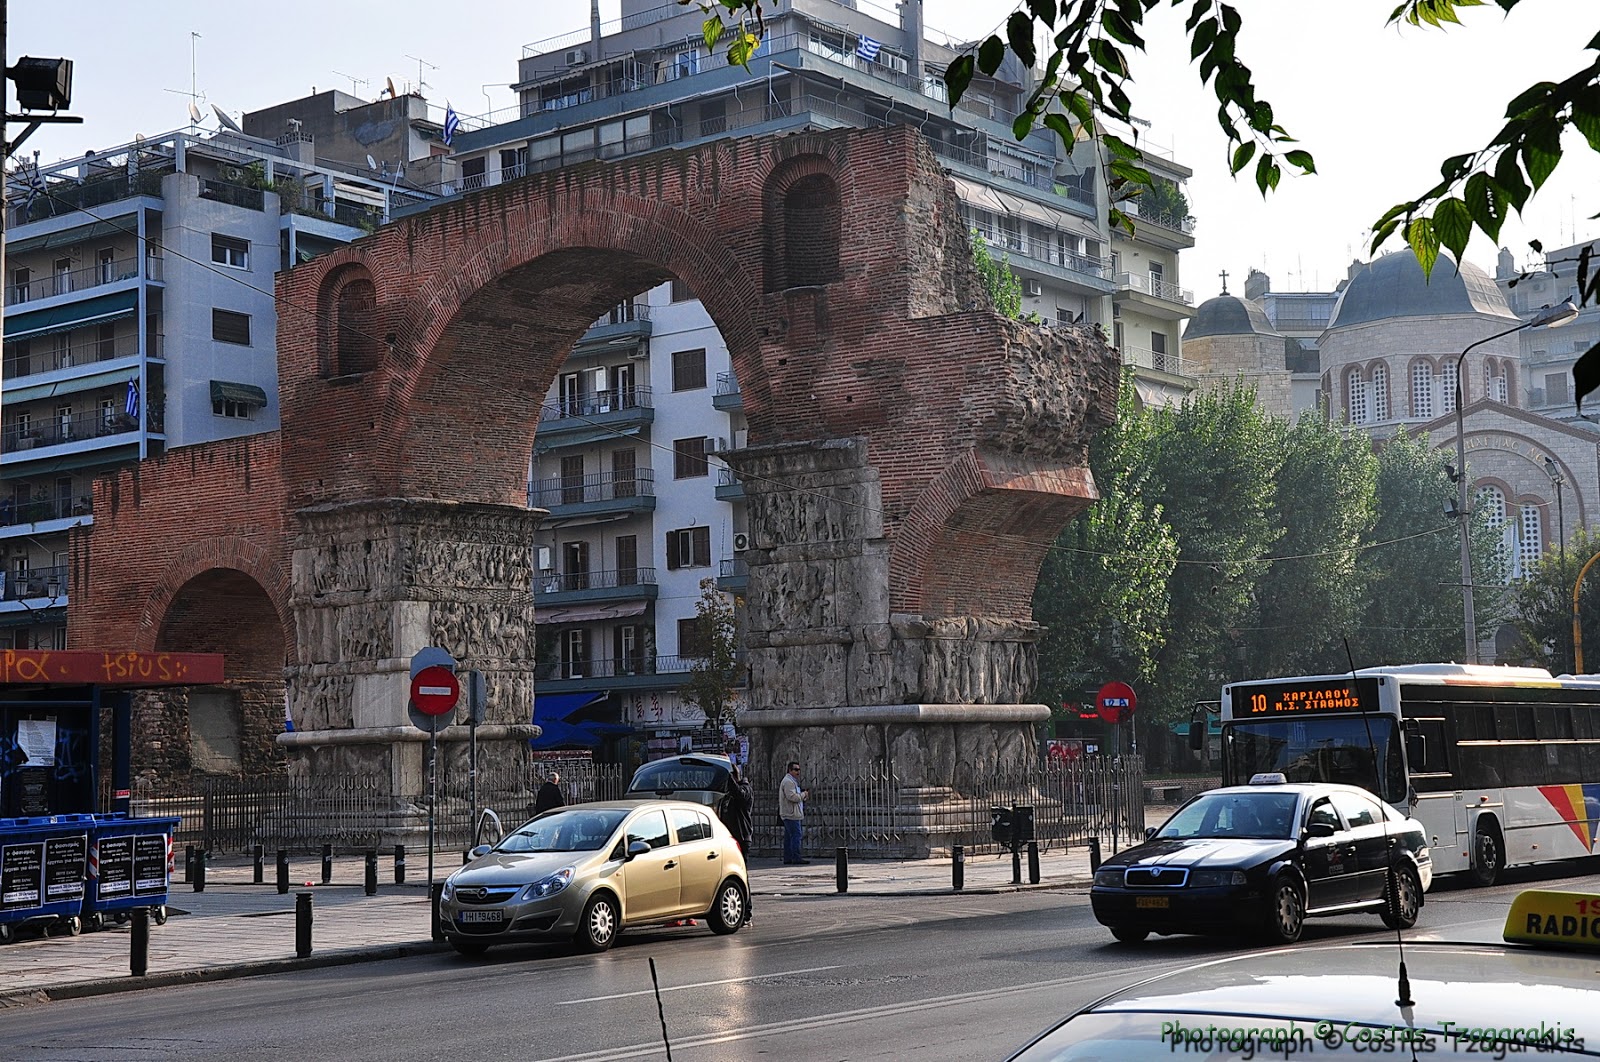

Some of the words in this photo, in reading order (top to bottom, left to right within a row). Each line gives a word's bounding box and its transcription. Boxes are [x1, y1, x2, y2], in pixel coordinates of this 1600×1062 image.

[1283, 689, 1350, 701] ΧΑΡΙΛΑΟΥ
[1251, 694, 1267, 712] 10
[1275, 702, 1299, 711] Ν.Σ.
[1305, 698, 1359, 710] ΣΤΑΘΜΟΣ
